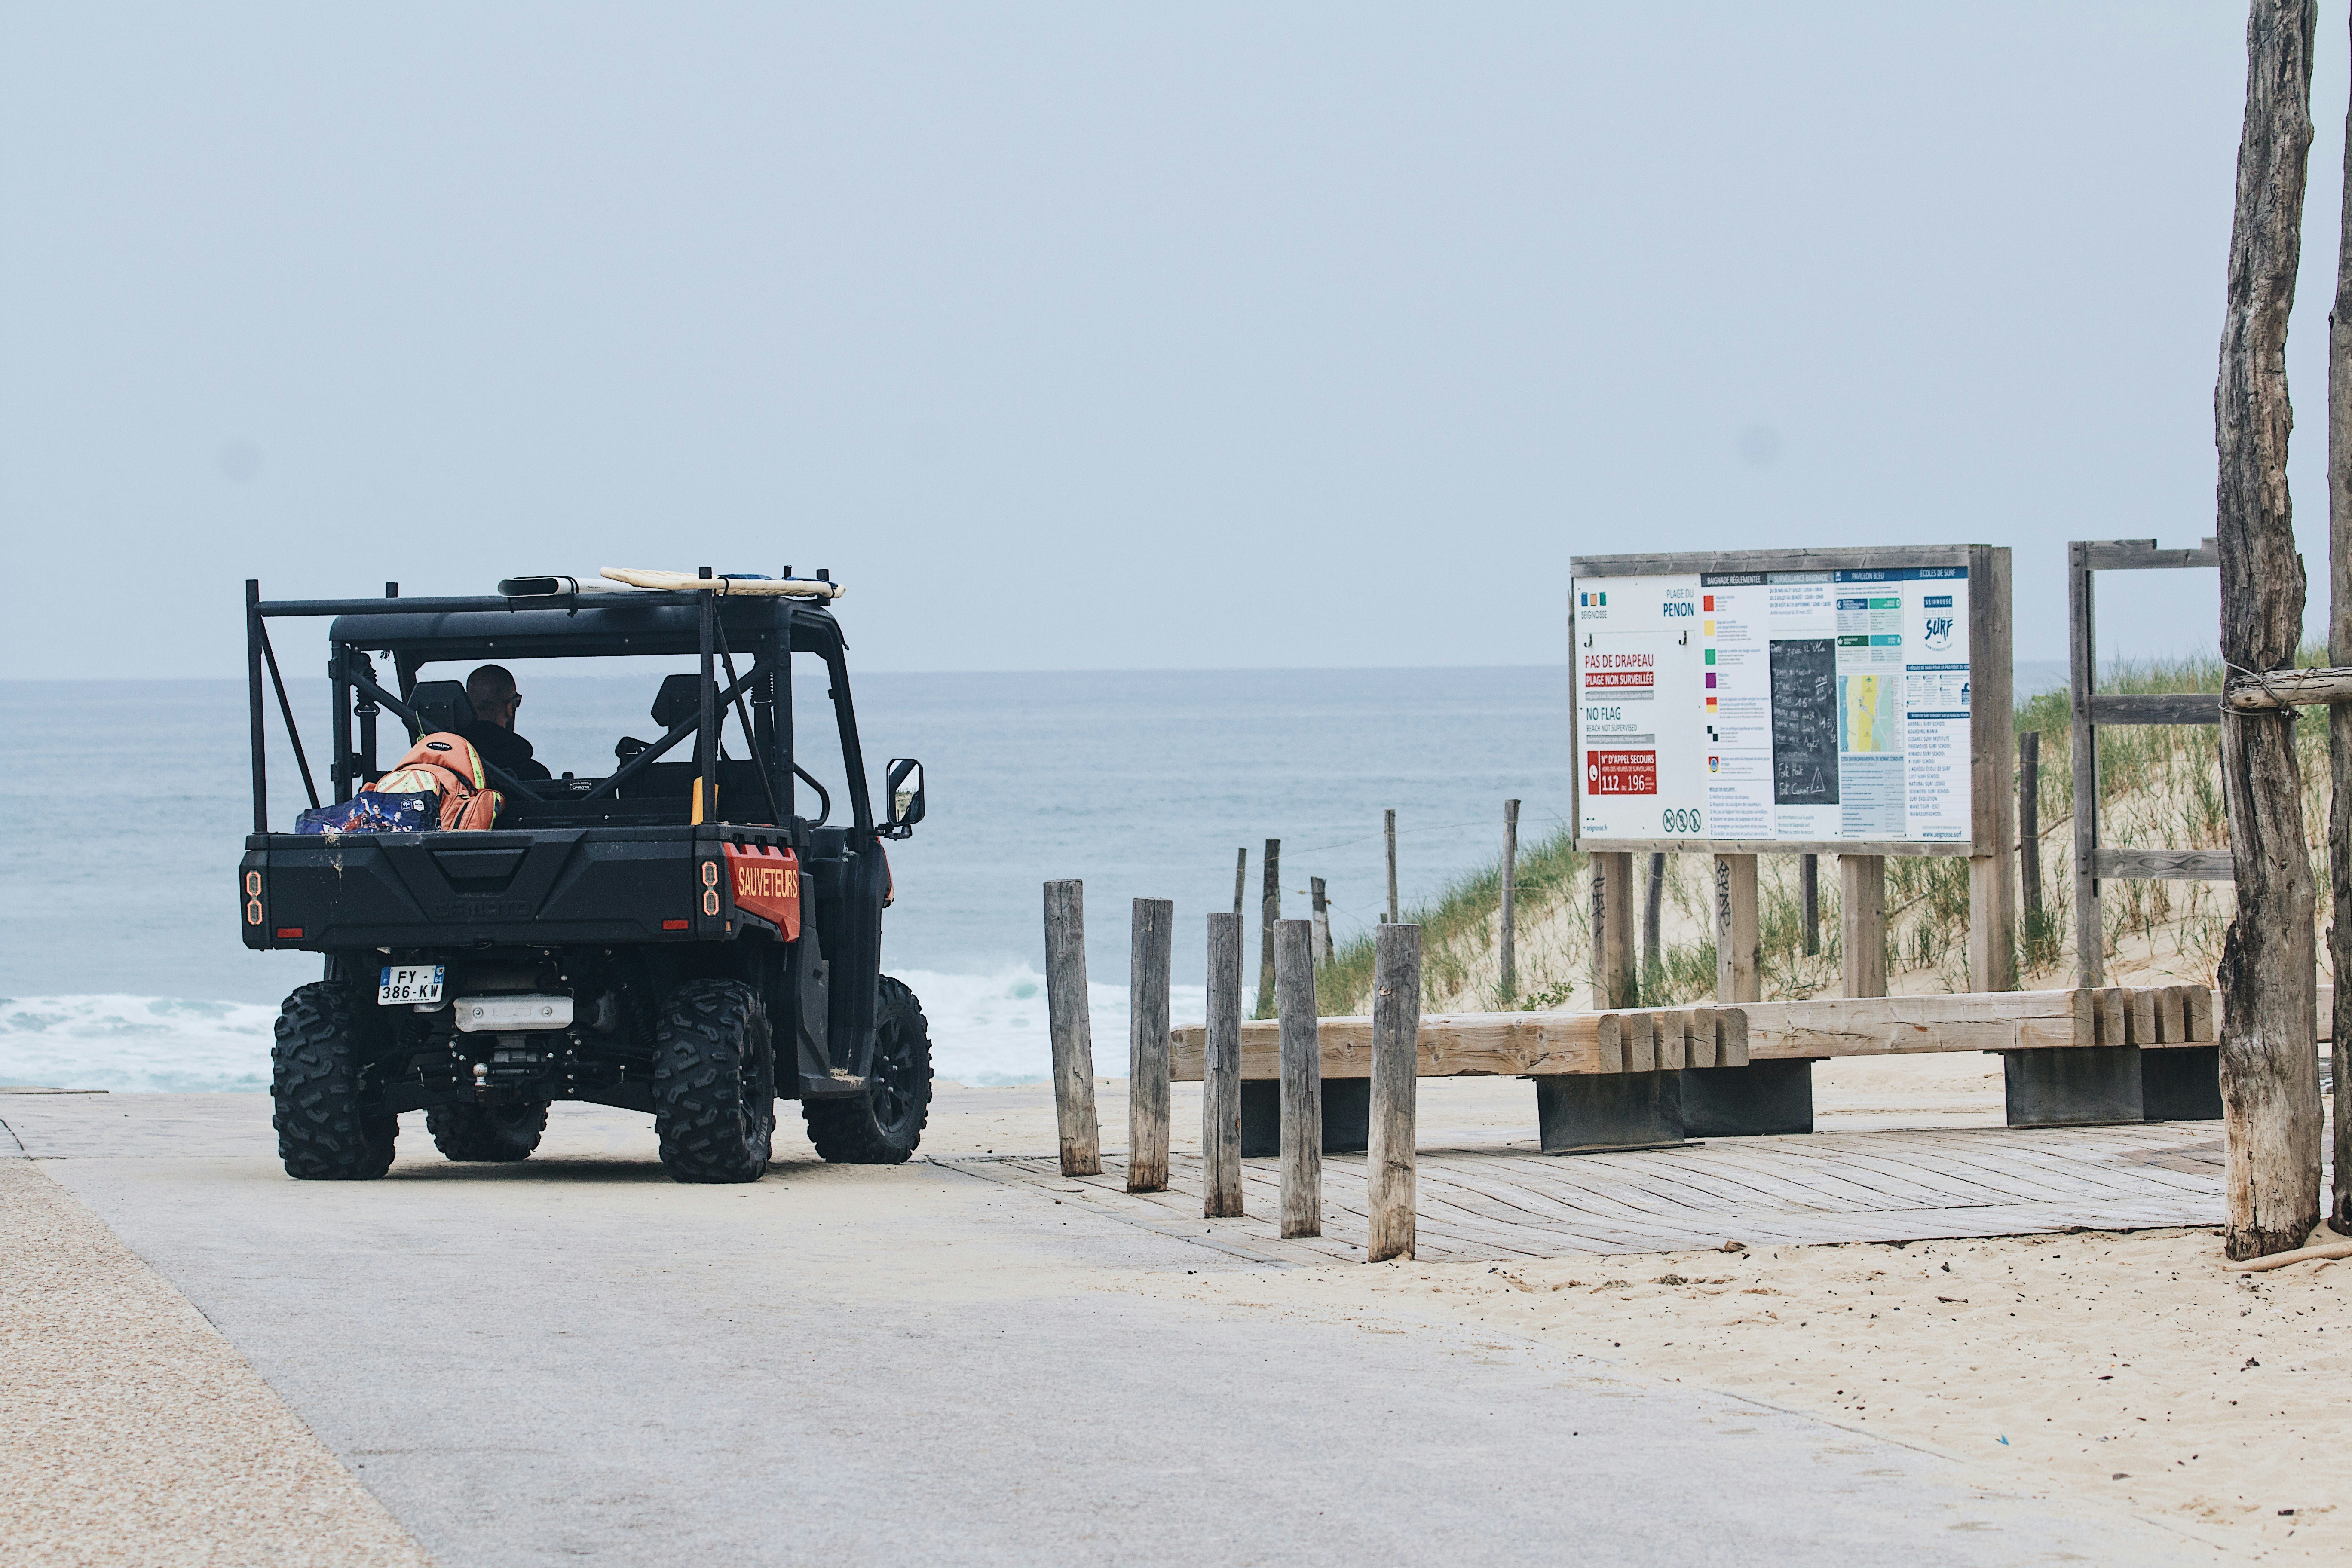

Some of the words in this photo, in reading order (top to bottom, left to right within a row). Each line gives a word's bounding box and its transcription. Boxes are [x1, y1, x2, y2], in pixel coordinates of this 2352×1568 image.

[1774, 574, 1805, 582] SURVEILLANCE
[1806, 573, 1828, 582] BAIGNADE
[1920, 568, 1936, 577] ÉCOLES
[1707, 576, 1730, 585] BAIGNADE
[1667, 590, 1684, 598] PLAGE
[1685, 589, 1694, 598] DU
[1581, 610, 1607, 619] SEIGNOSSE
[1663, 602, 1694, 617] PENON
[1925, 617, 1953, 641] SURF
[1586, 655, 1600, 668] PAS
[1602, 655, 1613, 668] DE
[1615, 654, 1654, 668] DRAPEAU
[1586, 675, 1604, 685] PLAGE
[1605, 674, 1618, 685] NON
[1620, 672, 1653, 685] SURVEILLÉE
[1586, 707, 1599, 720] NO
[1602, 707, 1621, 720] FLAG
[1608, 754, 1630, 764] D'APPEL
[1630, 755, 1654, 764] SECOURS
[1602, 775, 1619, 791] 112
[1628, 775, 1645, 791] 196
[1923, 830, 1961, 839] www.seignosse.surf
[738, 867, 798, 898] SAUVETEURS
[398, 971, 416, 984] FY
[382, 984, 439, 999] 386-KW
